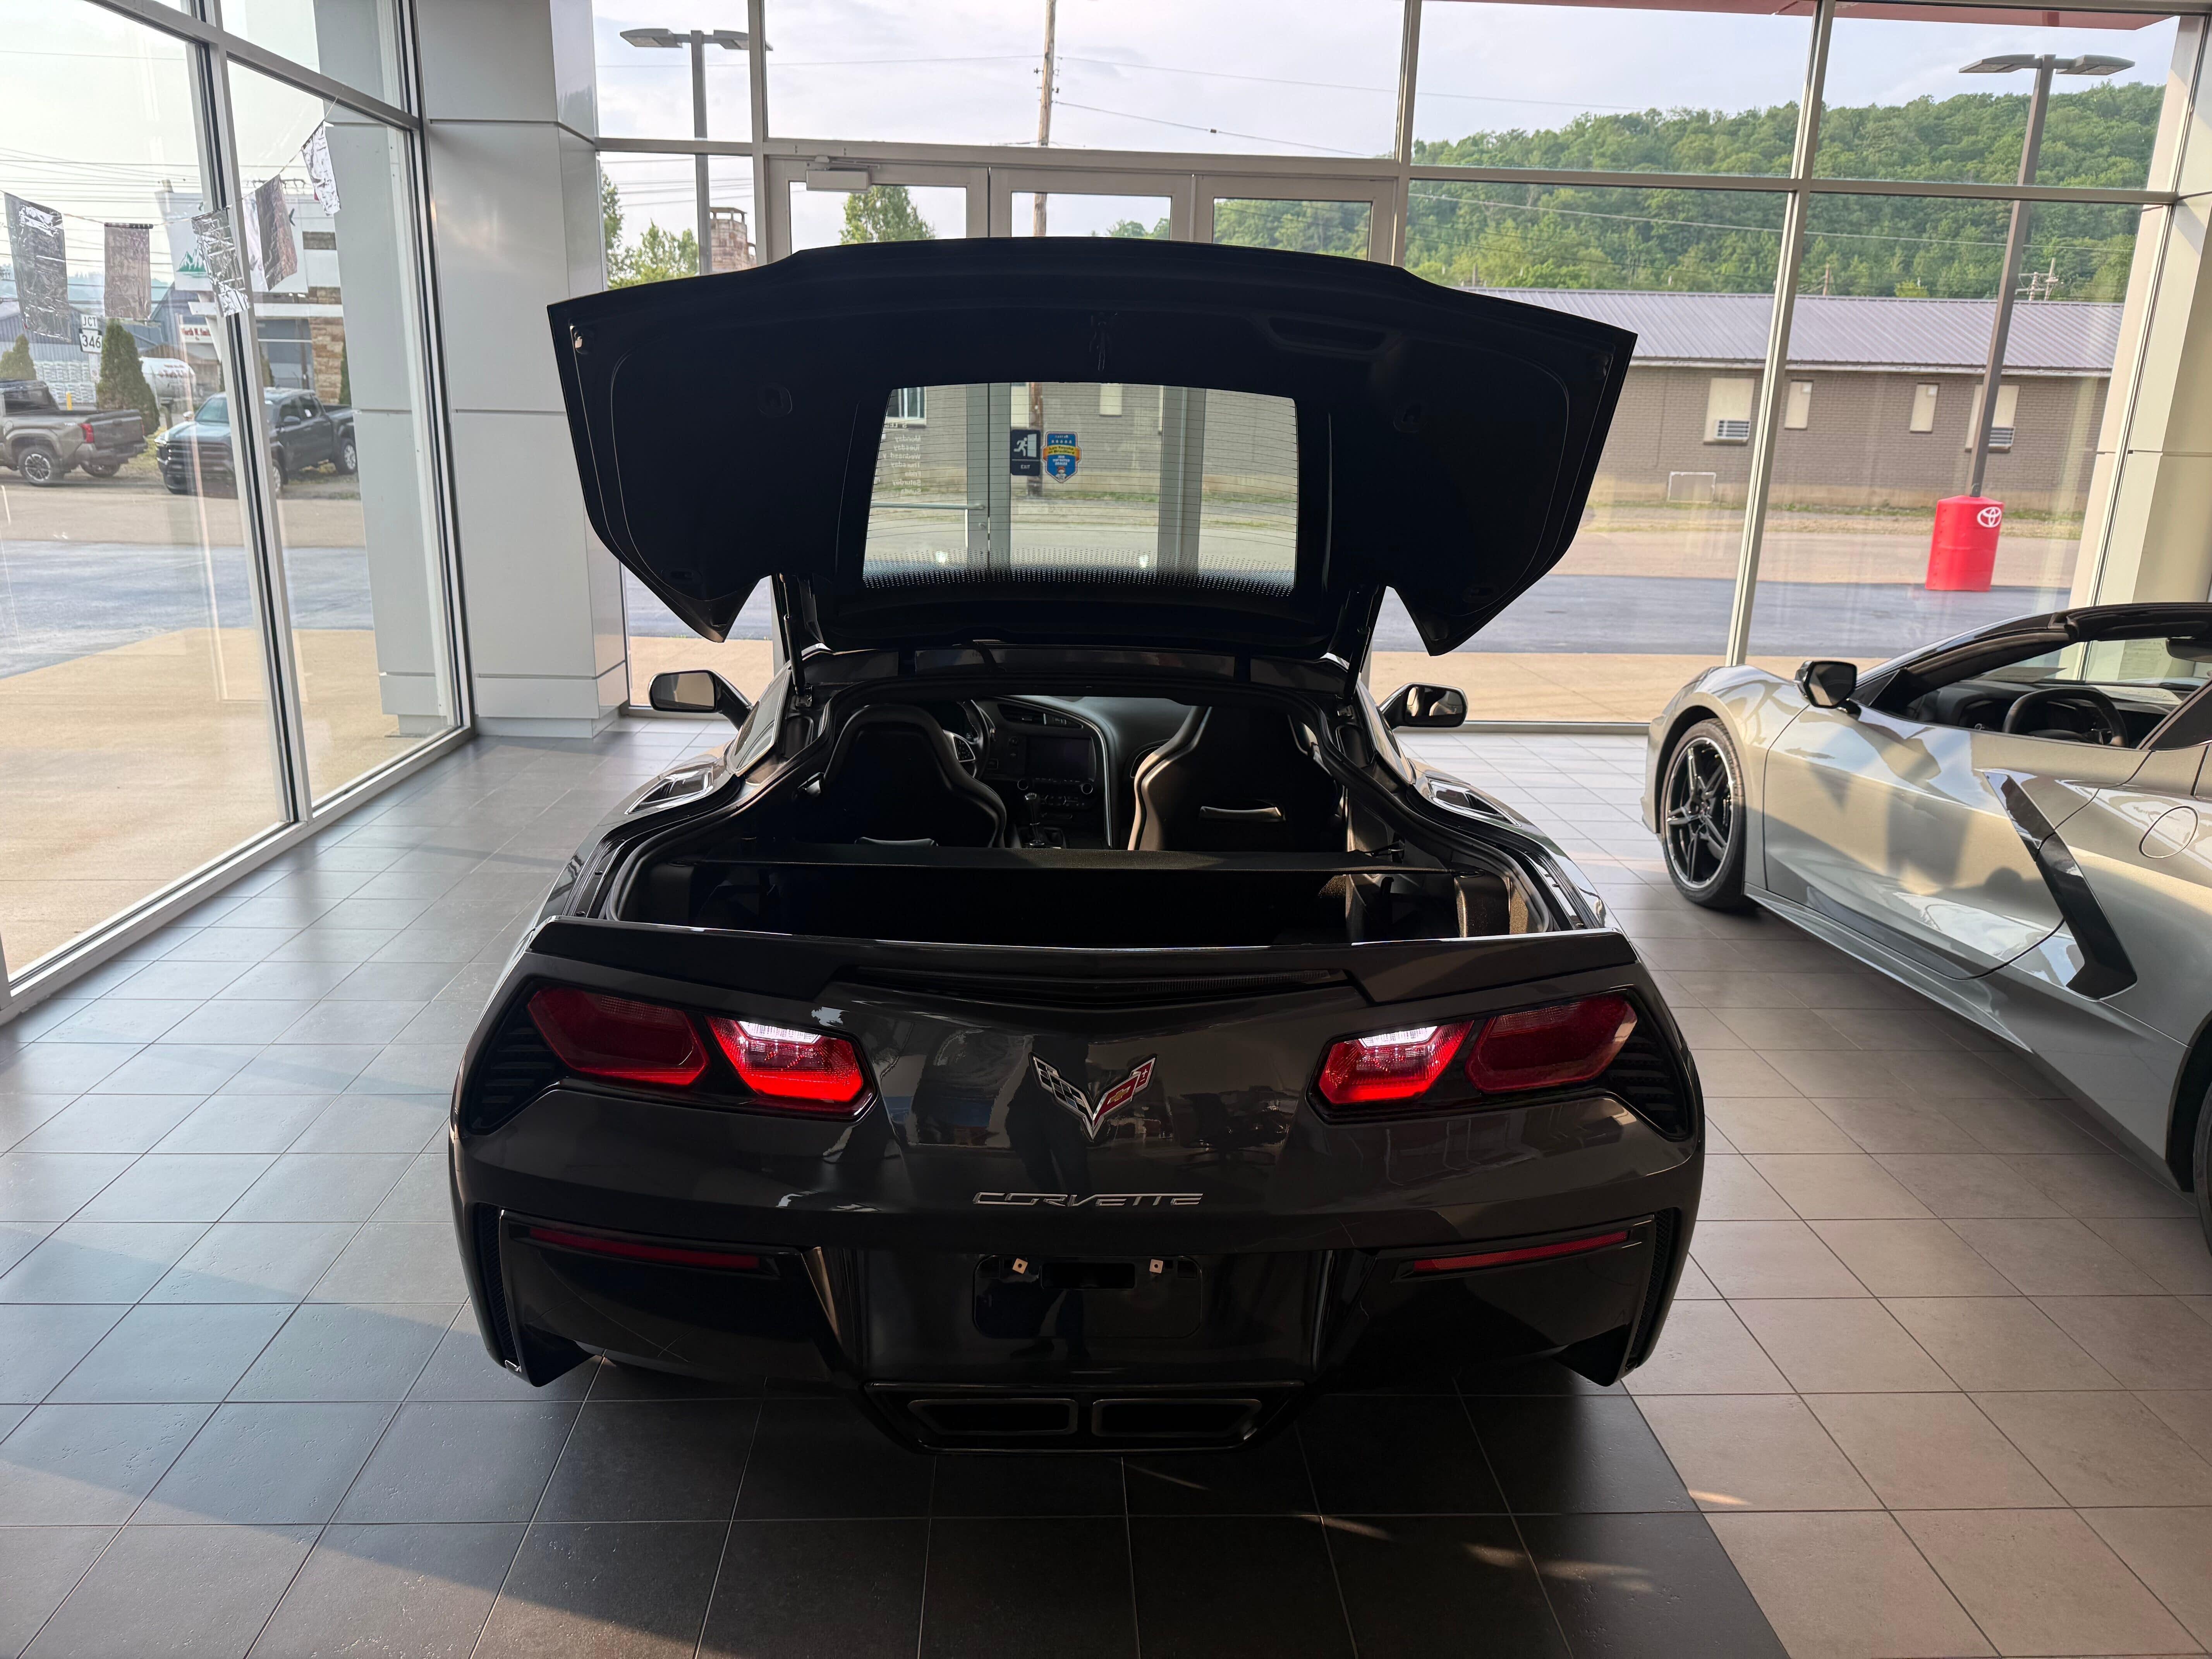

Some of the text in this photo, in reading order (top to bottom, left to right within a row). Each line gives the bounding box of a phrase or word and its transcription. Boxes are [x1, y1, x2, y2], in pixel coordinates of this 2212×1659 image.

[82, 316, 96, 327] JCT
[82, 335, 101, 349] 346
[972, 1192, 1204, 1207] CORVETTE
